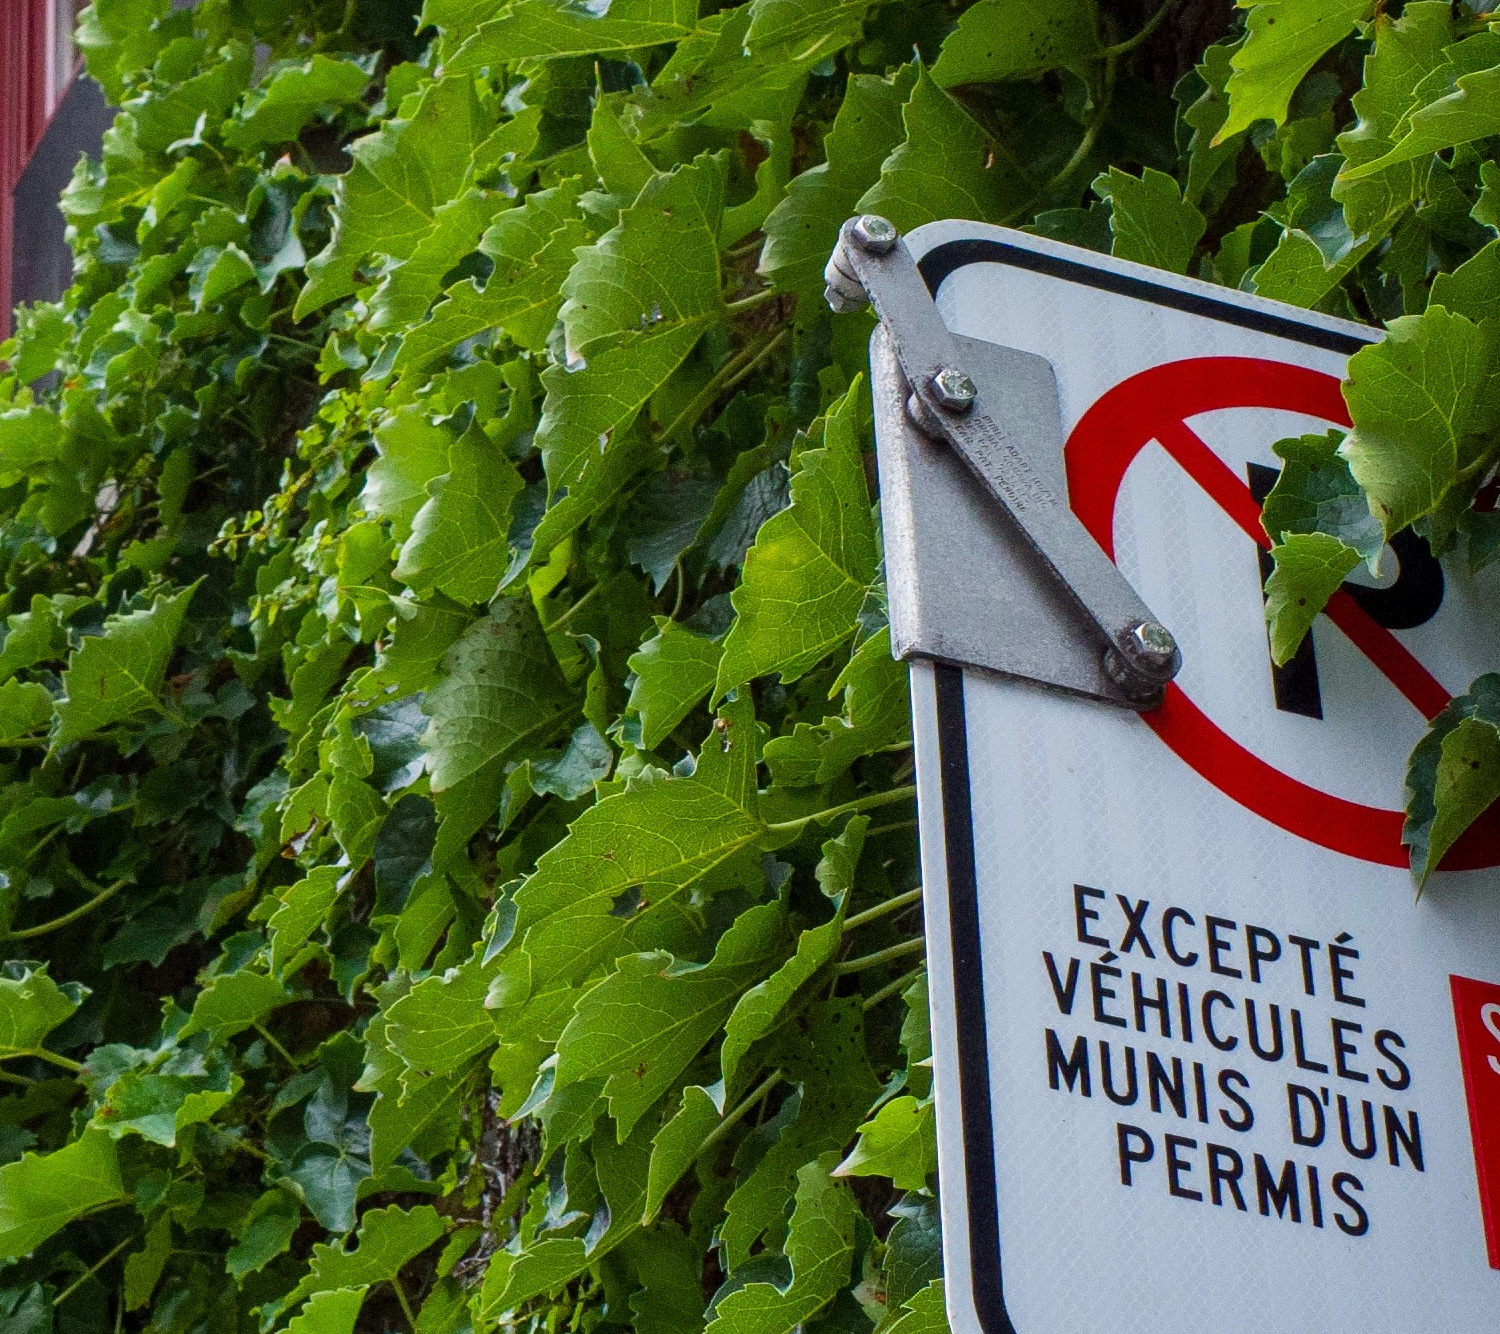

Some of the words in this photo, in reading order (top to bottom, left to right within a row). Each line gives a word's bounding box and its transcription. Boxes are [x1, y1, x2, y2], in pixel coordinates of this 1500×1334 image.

[1073, 883, 1366, 1008] EXCEPTÉ
[1042, 950, 1411, 1091] VÉHICULES
[1045, 1027, 1254, 1133] MUNIS
[1286, 1082, 1425, 1173] D'UN
[1116, 1122, 1369, 1237] PERMIS
